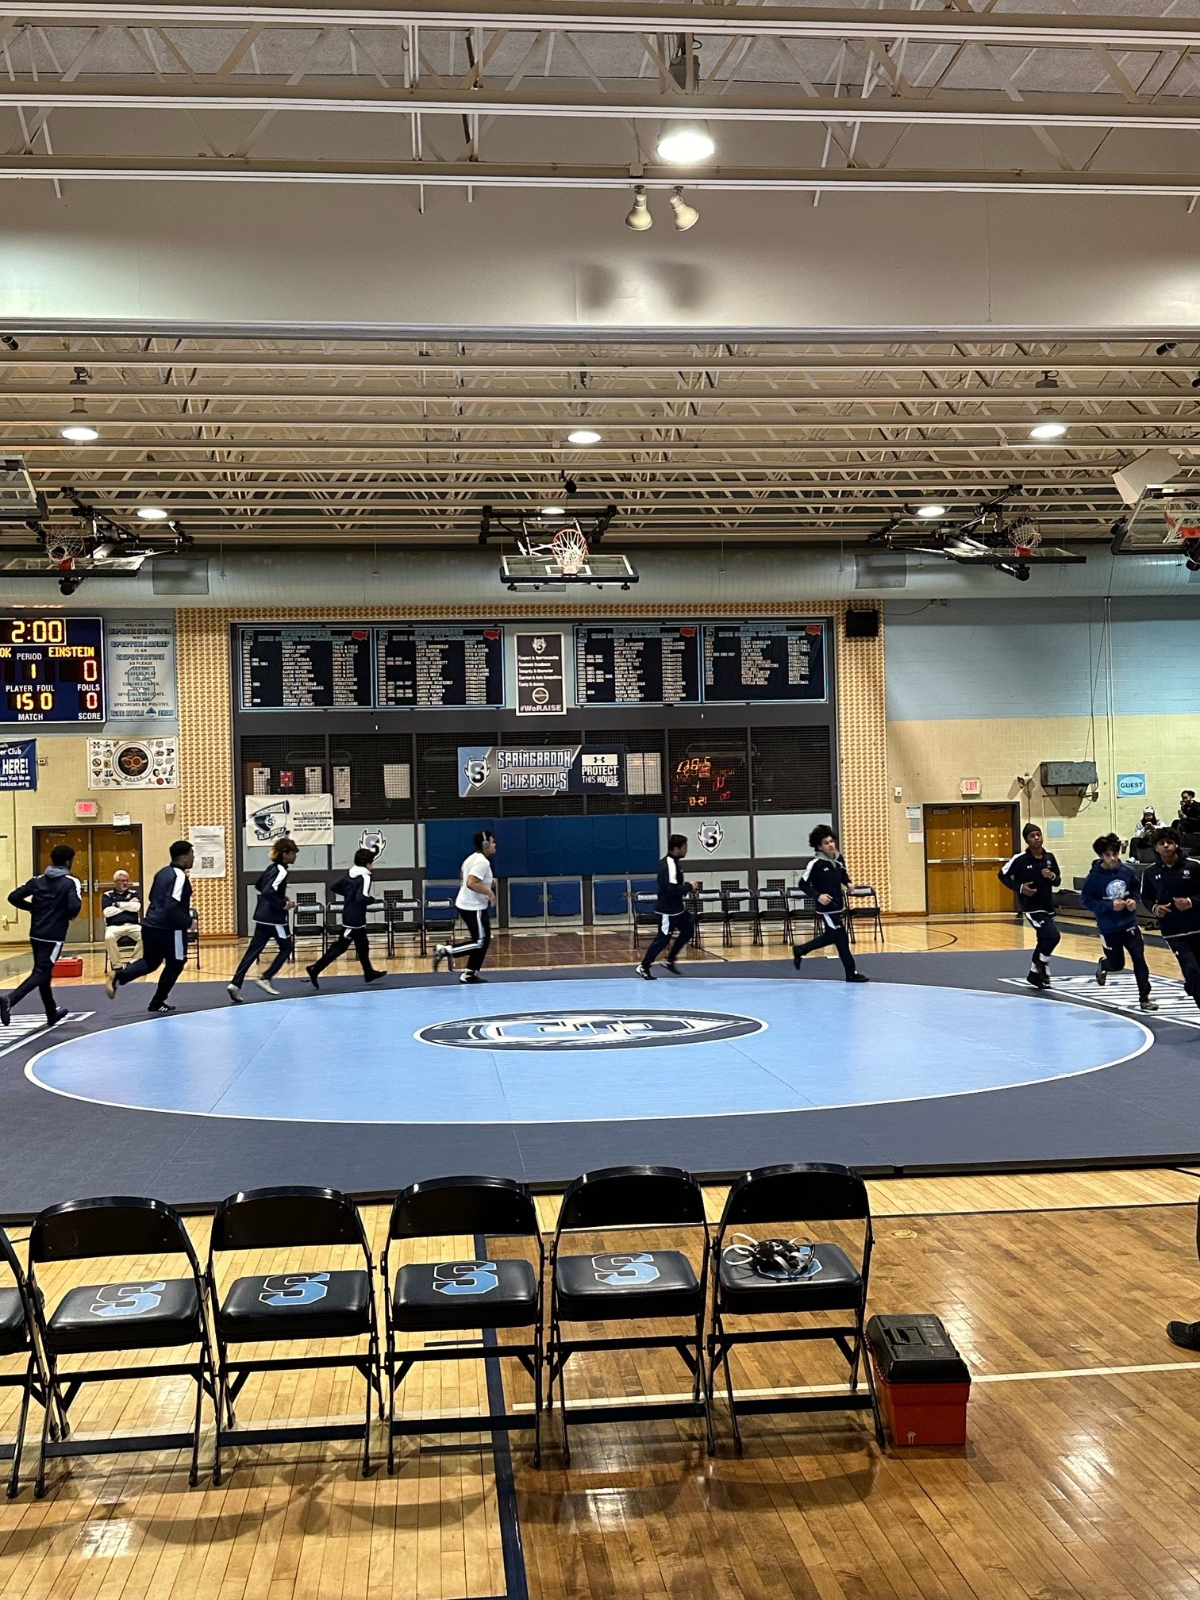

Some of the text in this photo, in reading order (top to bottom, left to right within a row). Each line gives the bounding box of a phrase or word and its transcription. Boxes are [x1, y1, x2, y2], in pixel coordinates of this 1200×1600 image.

[11, 620, 62, 643] 2:00
[16, 652, 42, 660] PERIOD
[48, 646, 94, 658] EINSTEIN
[31, 663, 36, 679] 1
[84, 660, 98, 681] 0
[6, 684, 55, 692] PLAYER FOUL
[78, 684, 100, 692] FOULS
[40, 692, 52, 710] 0
[86, 692, 98, 710] 0
[2, 758, 28, 774] HERE!
[498, 750, 572, 769] SPRINGBROOK
[582, 766, 619, 776] PROTECT
[502, 772, 568, 790] BLUE DEVILS
[582, 776, 596, 784] THIS
